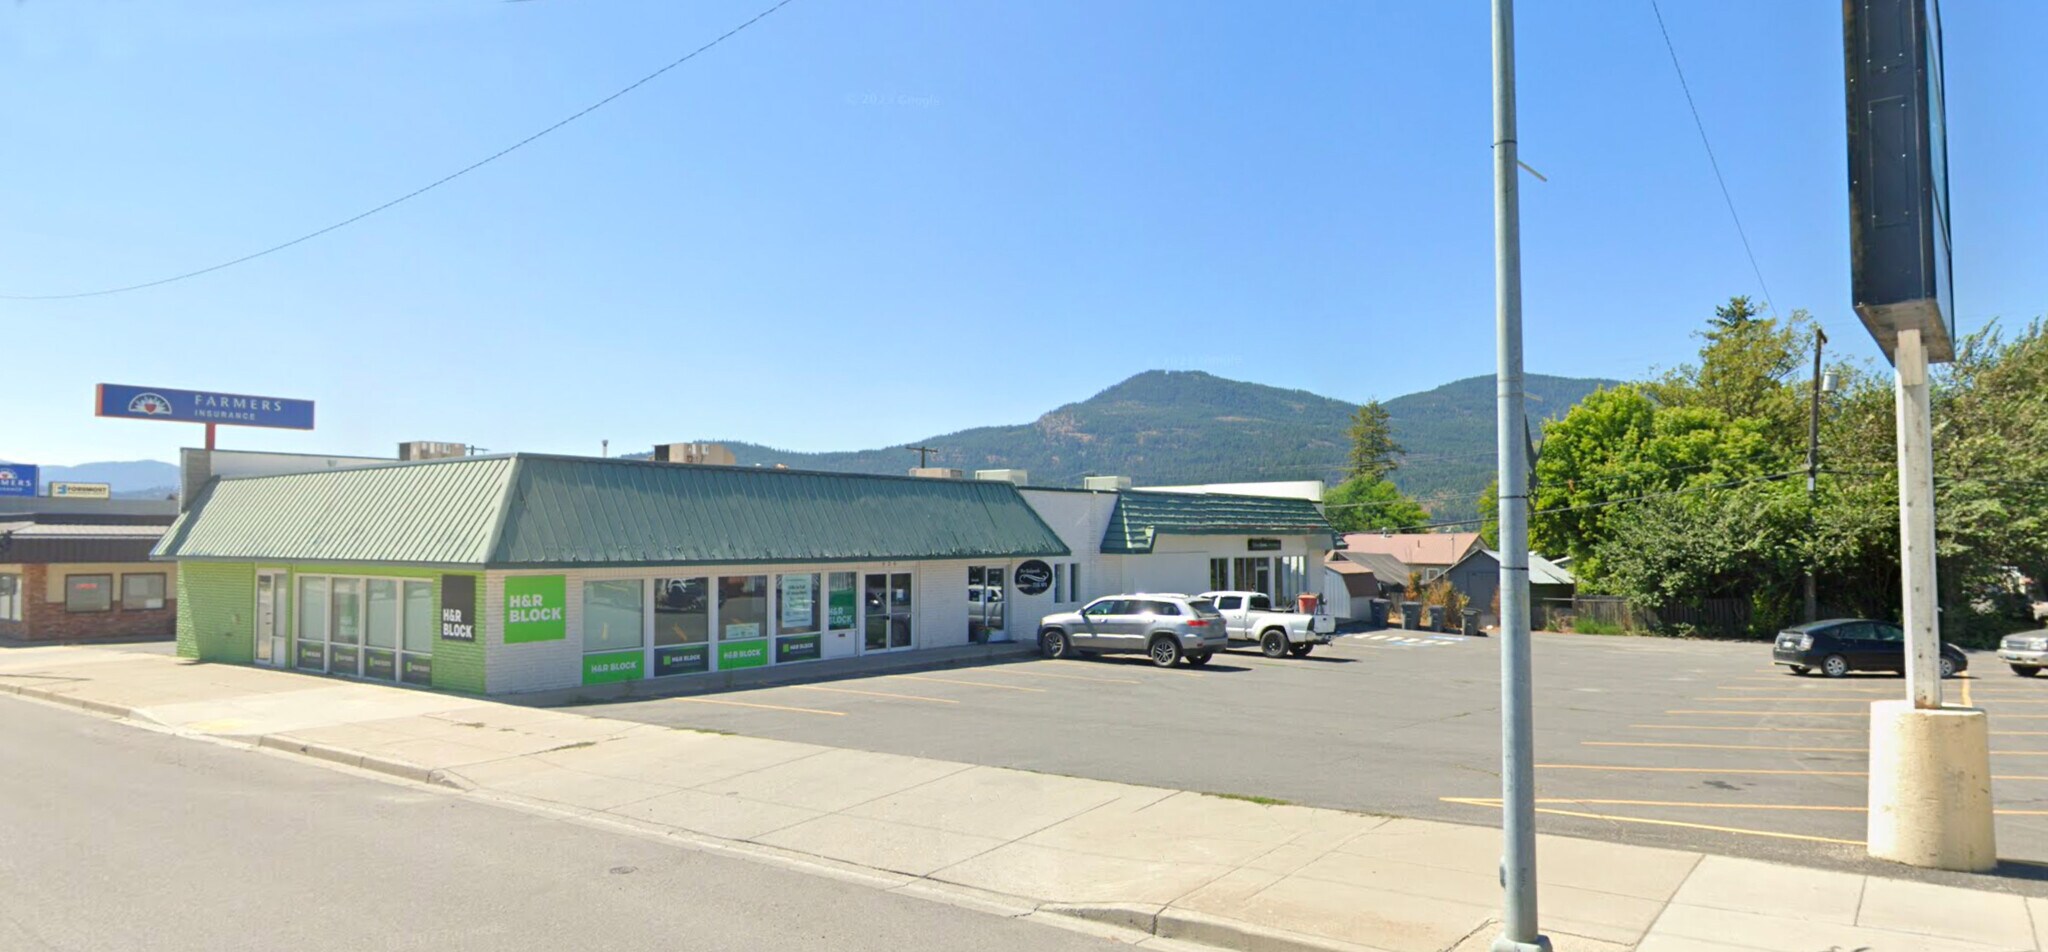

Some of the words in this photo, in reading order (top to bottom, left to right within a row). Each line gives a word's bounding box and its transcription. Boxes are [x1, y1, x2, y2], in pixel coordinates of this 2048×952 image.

[194, 394, 282, 412] FARMERS
[194, 410, 256, 421] INSURANCE
[509, 594, 543, 608] H&R
[443, 608, 462, 622] H&R
[509, 607, 562, 623] BLOCK
[443, 623, 473, 639] BLOCK
[739, 648, 762, 658] BLOCK
[591, 664, 608, 673] H&R
[610, 661, 637, 671] BLOCK
